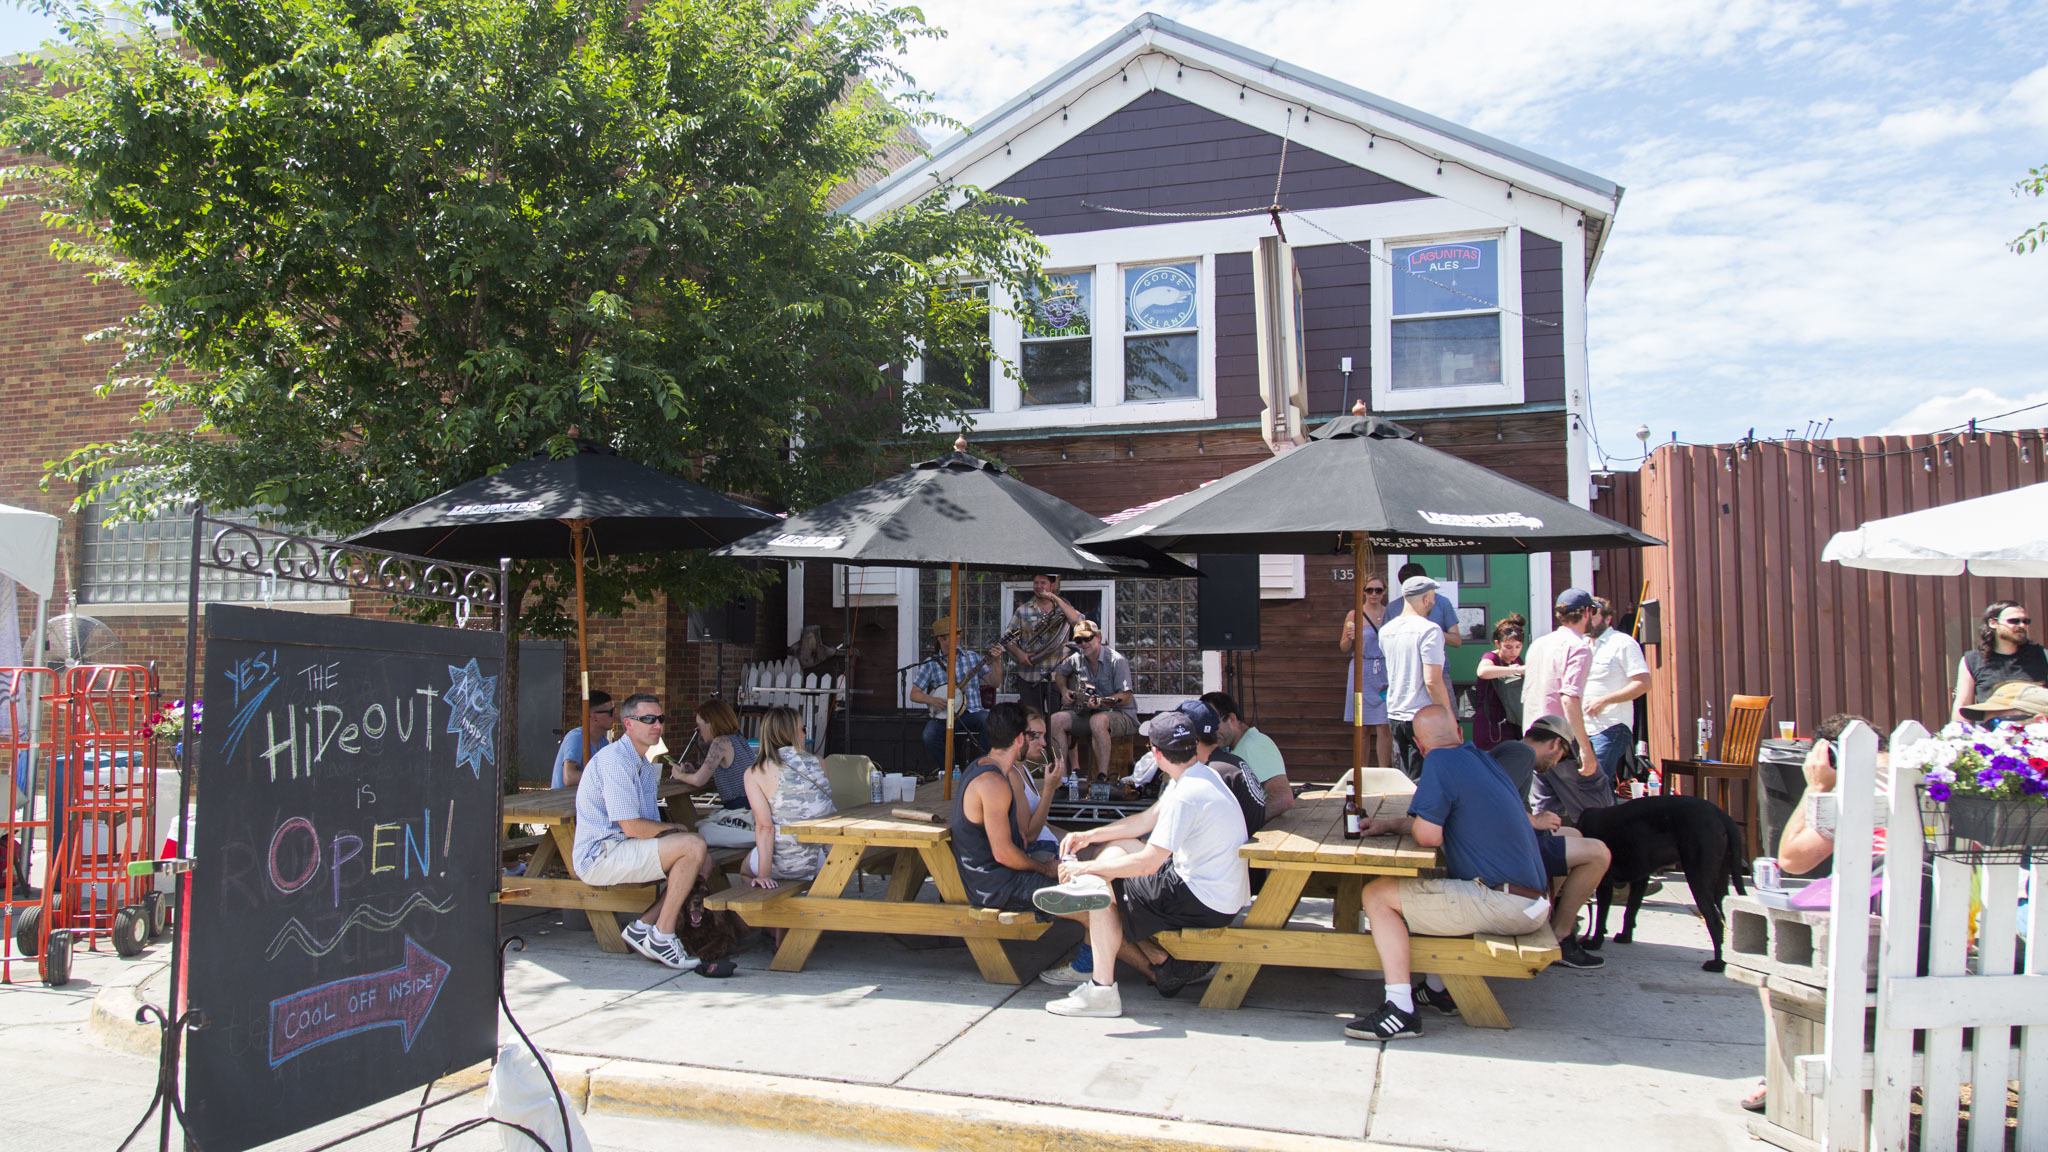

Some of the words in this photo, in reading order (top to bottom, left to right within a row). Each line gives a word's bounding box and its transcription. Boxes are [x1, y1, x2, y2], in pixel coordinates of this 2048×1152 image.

[1412, 249, 1478, 264] LAGUNITAS
[1429, 261, 1459, 271] ALES
[1143, 272, 1184, 287] GOOSE
[1038, 325, 1047, 336] 3
[1143, 311, 1186, 328] ISLAND
[224, 649, 277, 708] YES!
[297, 661, 341, 691] THE
[462, 717, 487, 745] INSIDE
[268, 800, 454, 908] OPEN!
[284, 1001, 336, 1039] COOL
[348, 989, 377, 1014] OFF
[388, 967, 439, 1002] INSIDE!
